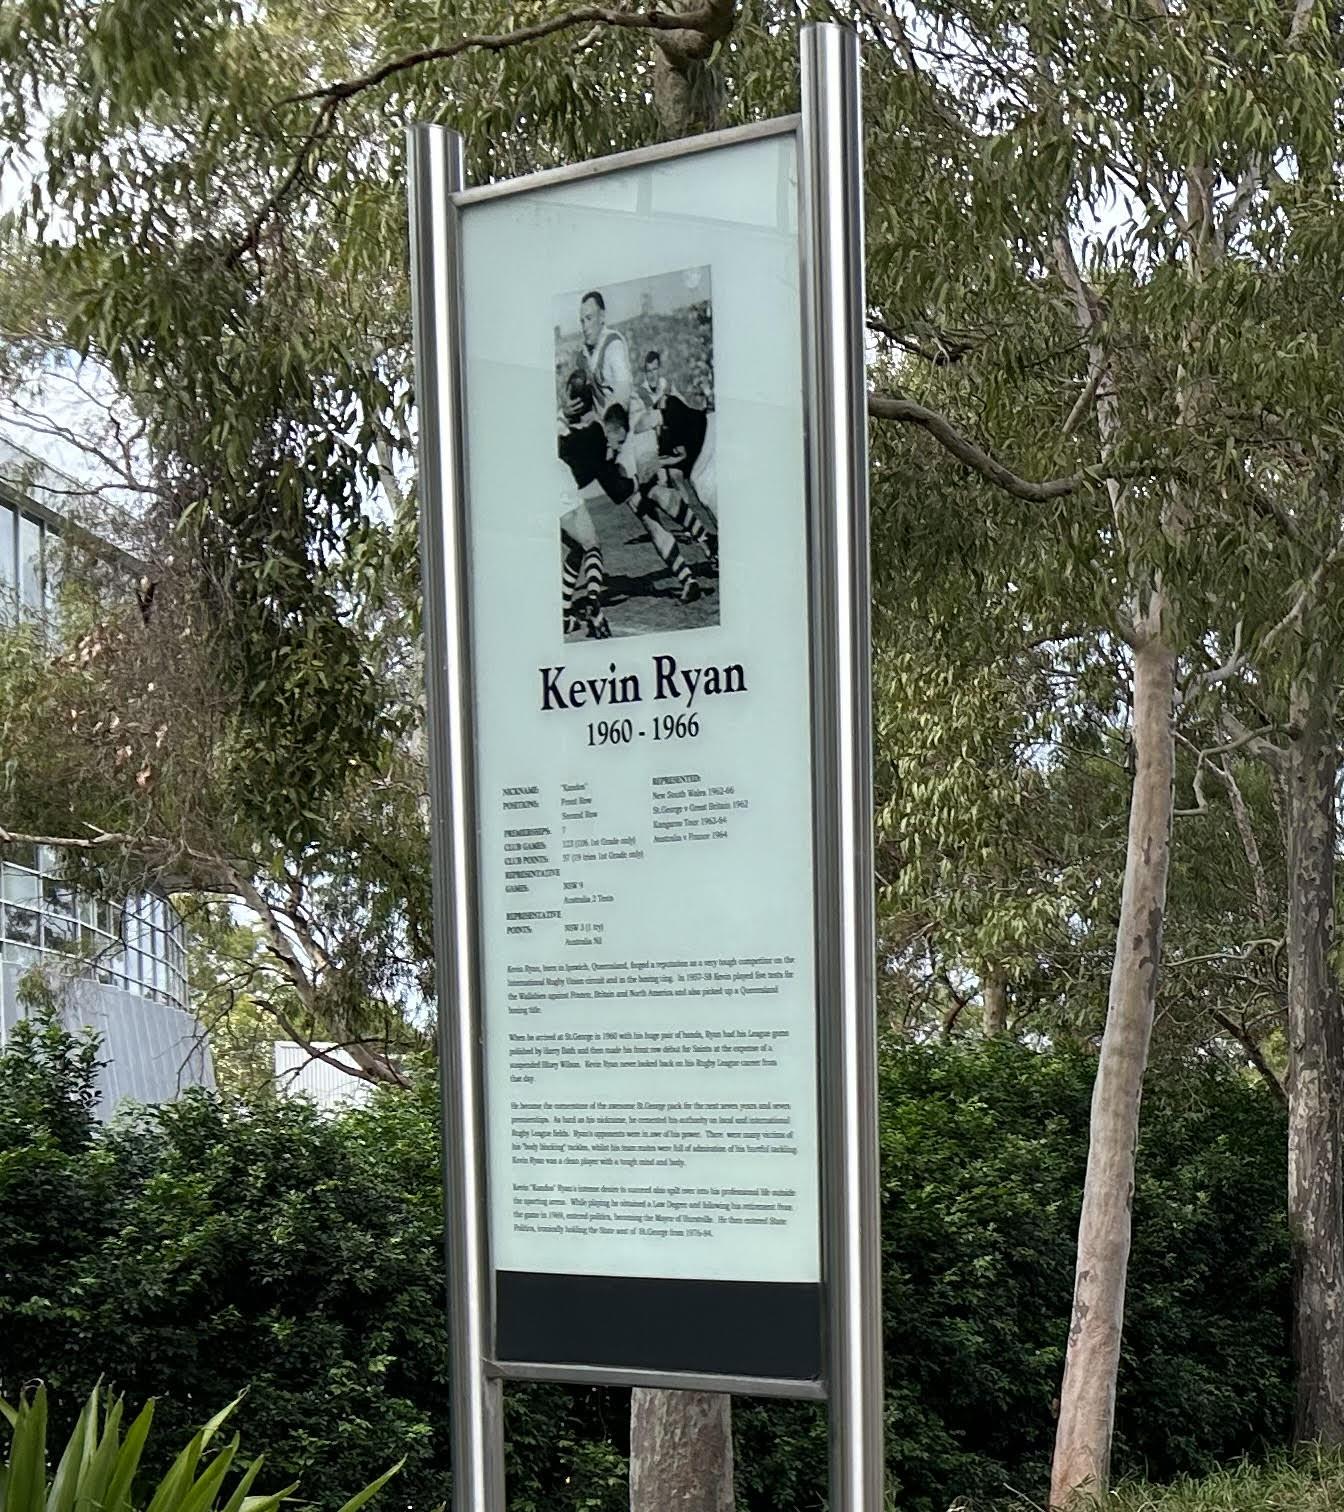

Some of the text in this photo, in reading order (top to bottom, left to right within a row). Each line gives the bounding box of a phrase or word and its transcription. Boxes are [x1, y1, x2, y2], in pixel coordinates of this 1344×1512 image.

[539, 654, 748, 711] Kevin Ryan
[587, 718, 632, 746] 1960
[652, 712, 700, 741] 1966
